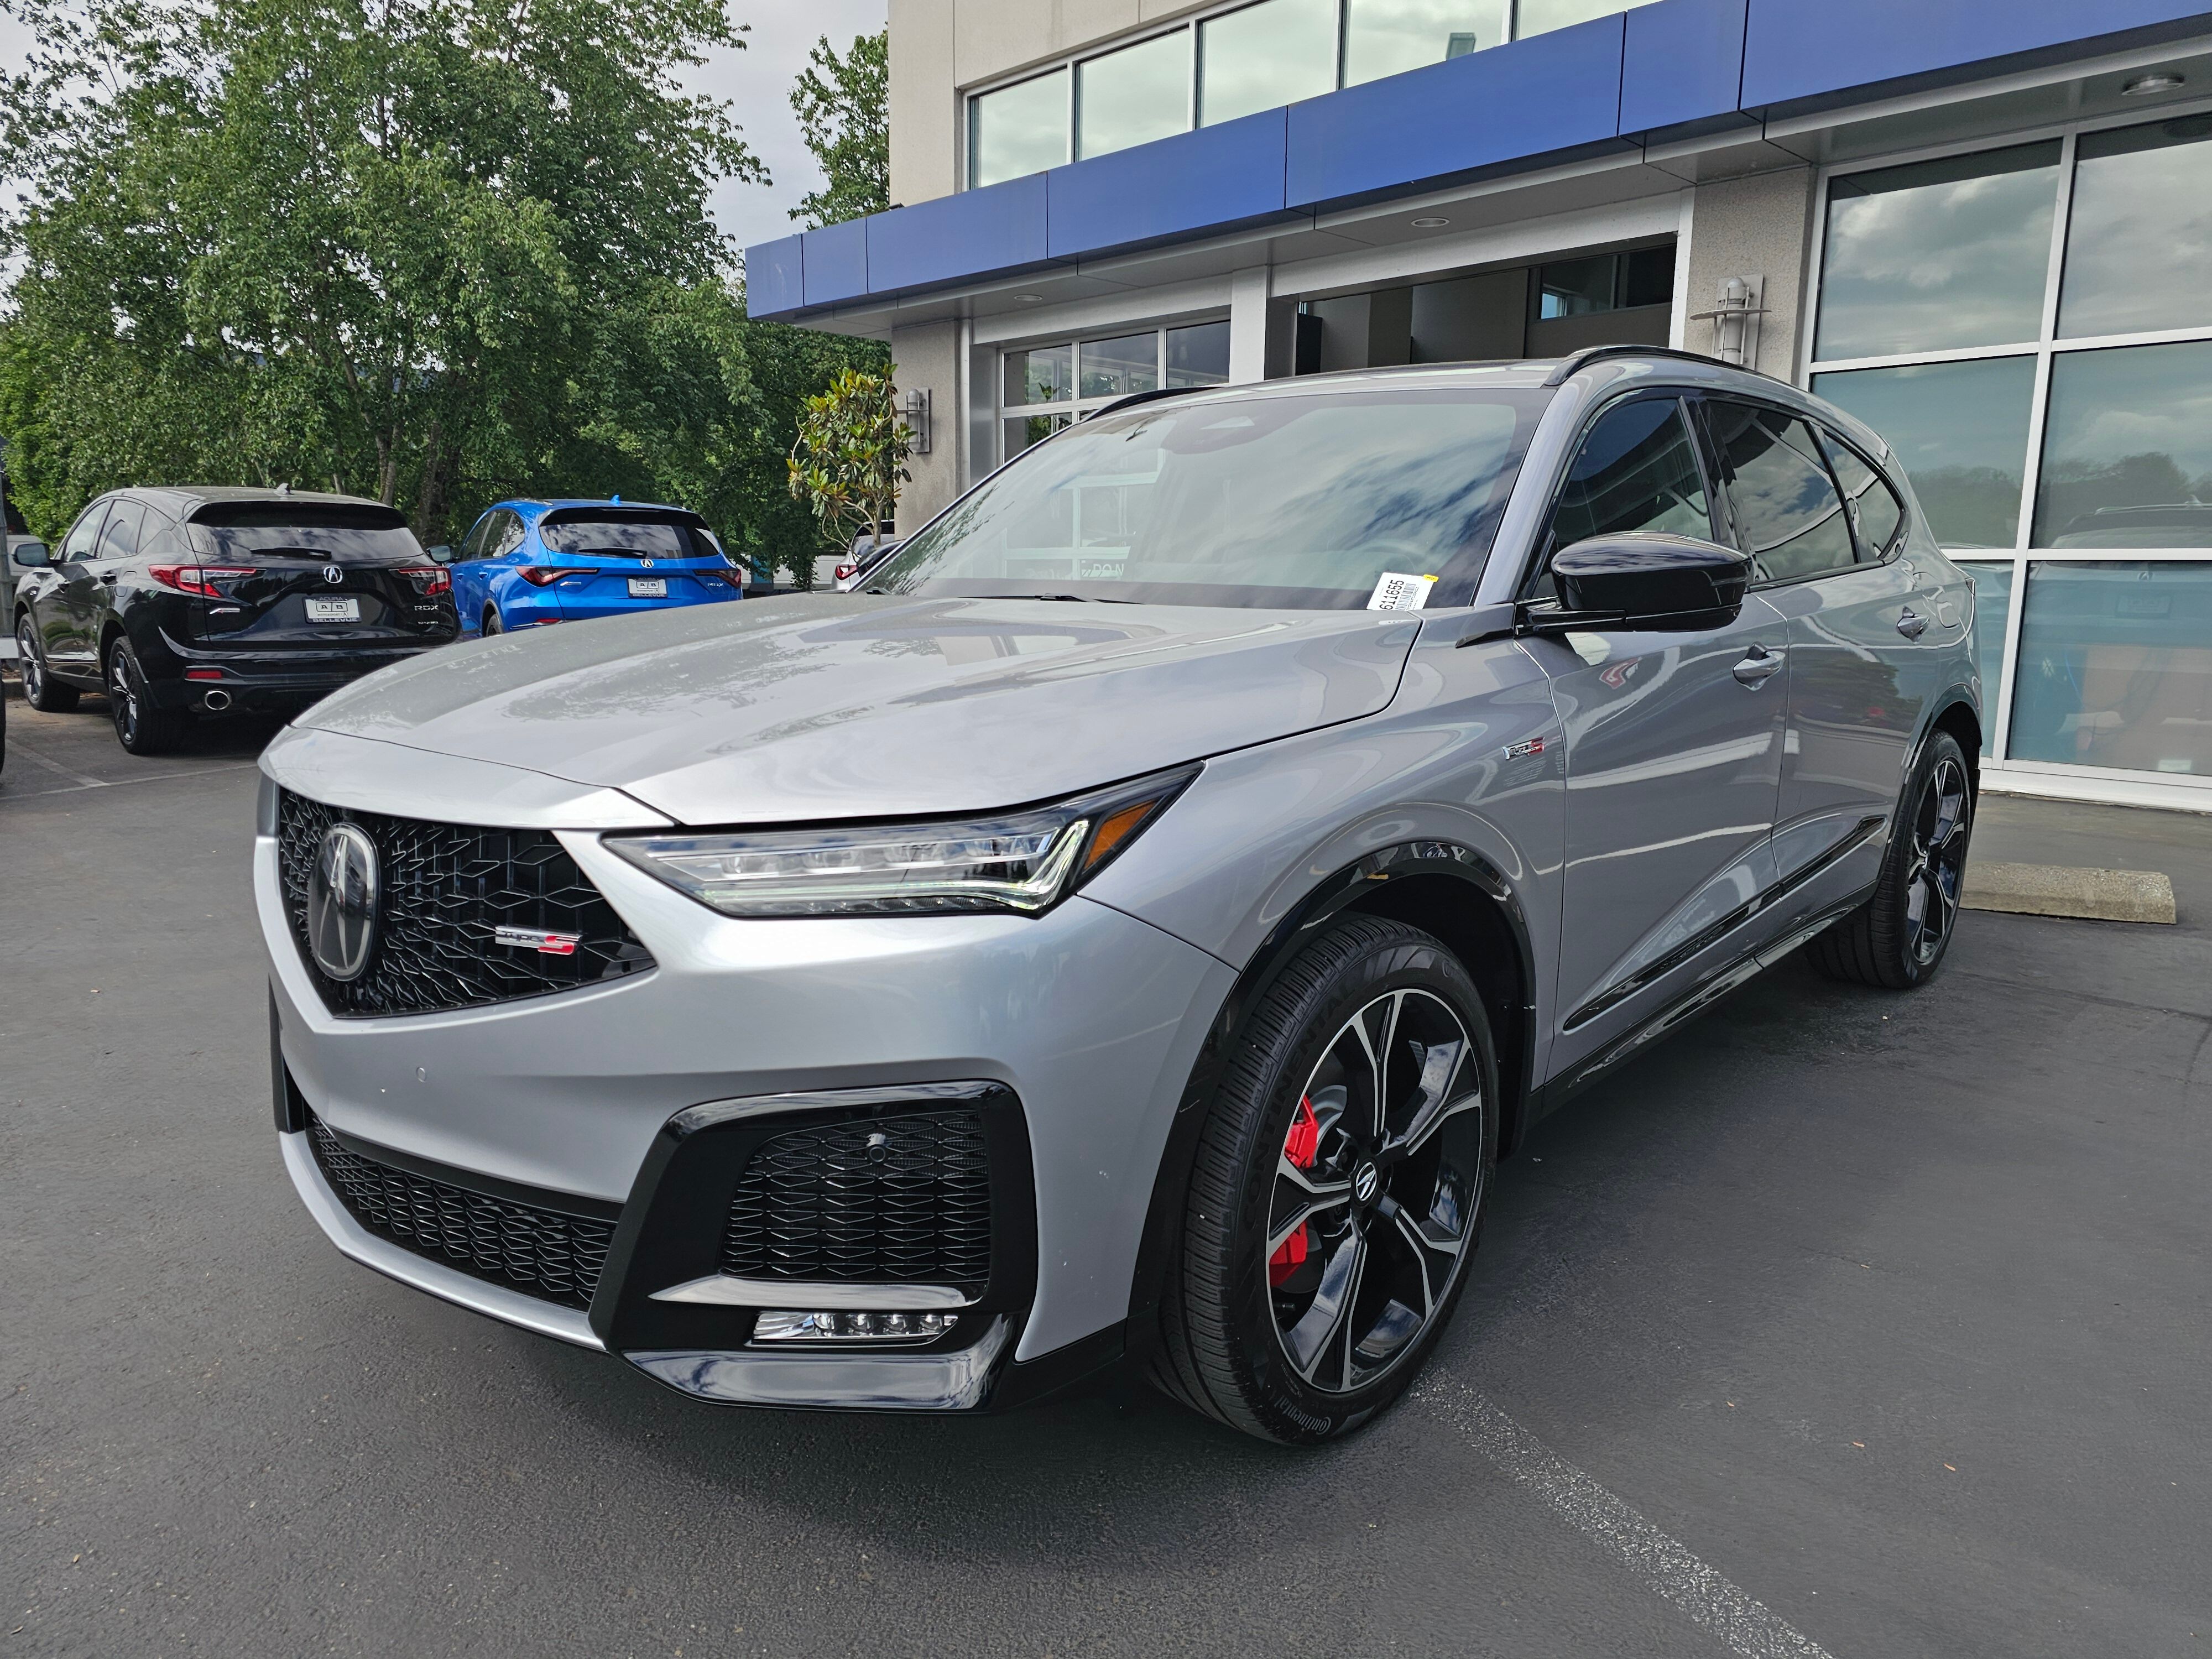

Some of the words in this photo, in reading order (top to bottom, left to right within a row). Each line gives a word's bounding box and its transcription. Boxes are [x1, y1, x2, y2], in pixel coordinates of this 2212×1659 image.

[1379, 580, 1405, 610] 611655
[538, 935, 576, 956] S
[1273, 1394, 1332, 1436] Continental
